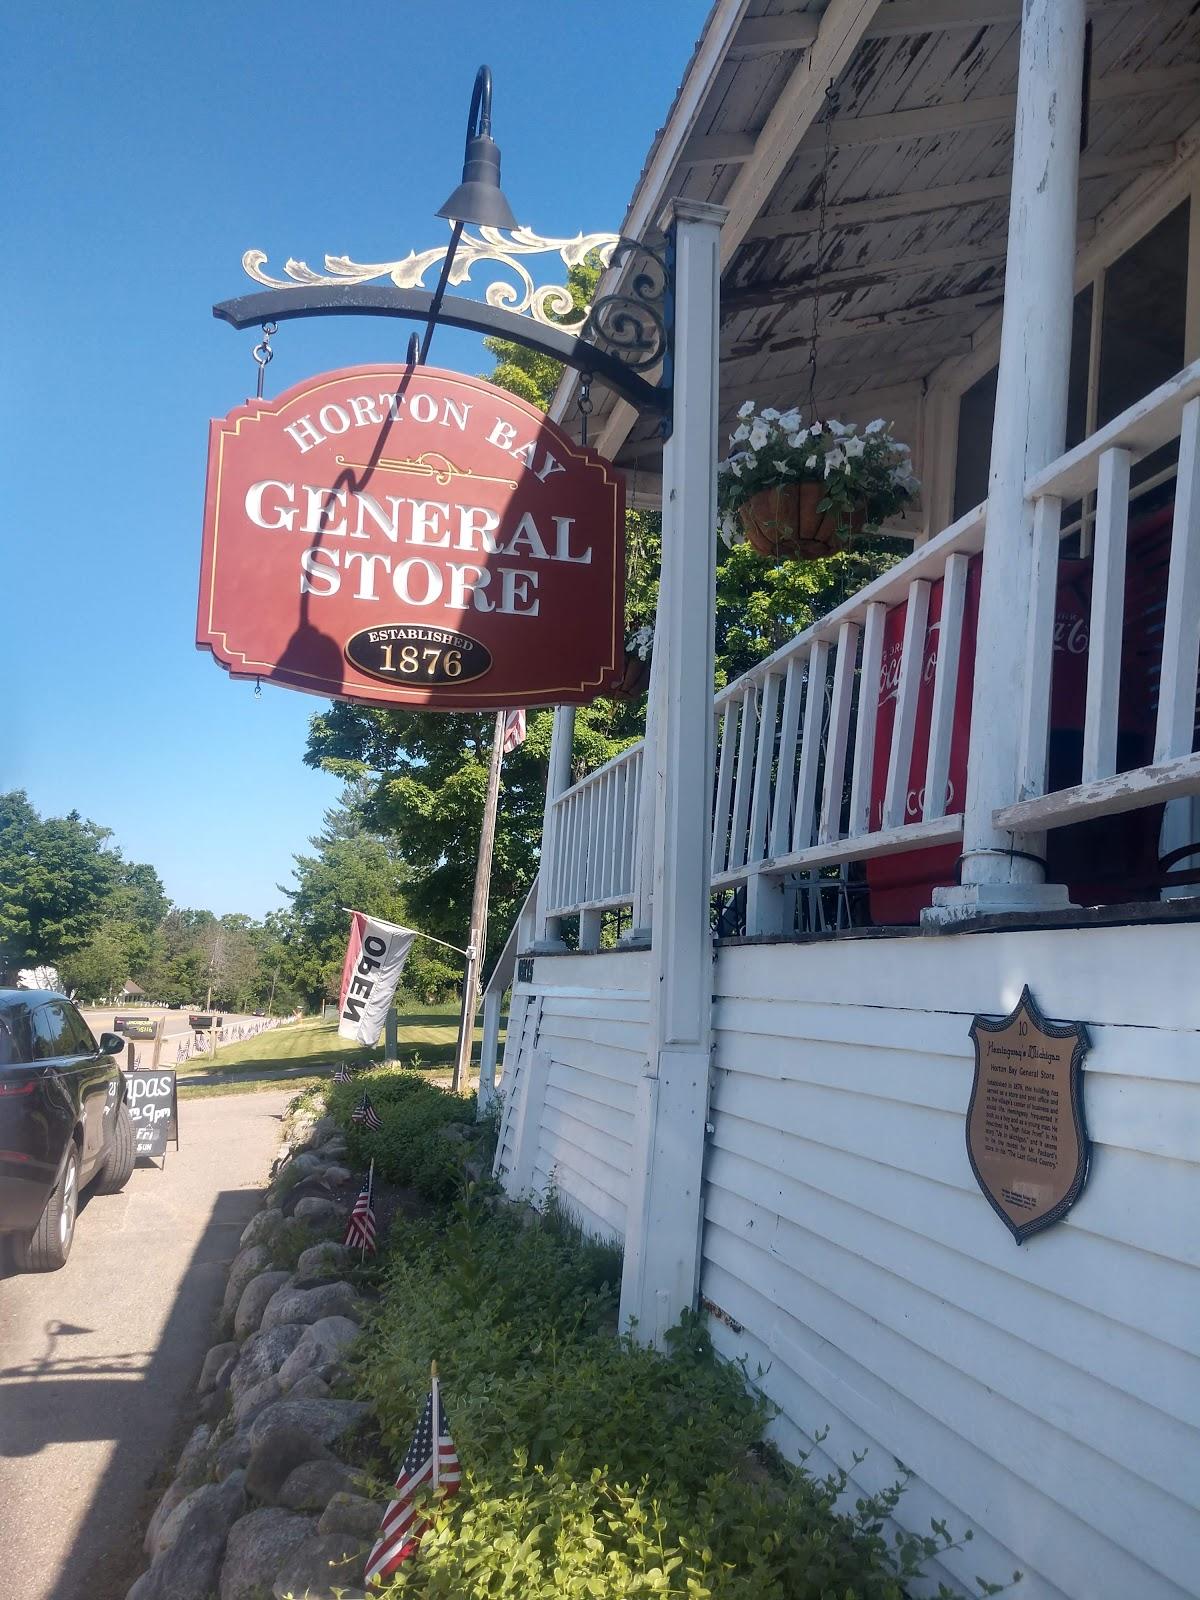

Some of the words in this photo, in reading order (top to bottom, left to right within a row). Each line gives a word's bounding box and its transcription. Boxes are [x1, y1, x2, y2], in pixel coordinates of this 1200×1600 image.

[283, 392, 474, 454] HORTON
[484, 416, 567, 484] BAY
[244, 479, 592, 565] GENERAL
[300, 546, 540, 617] STORE
[367, 629, 474, 652] ESTABLISHED
[378, 644, 463, 678] 1876
[1019, 1021, 1027, 1036] 10
[987, 1040, 1026, 1061] Hemingway's
[1028, 1045, 1060, 1064] Michigan
[991, 1064, 1006, 1073] Horton
[1009, 1066, 1017, 1076] Bay
[1020, 1067, 1039, 1078] General
[1041, 1071, 1055, 1080] Store
[124, 1074, 171, 1107] apas
